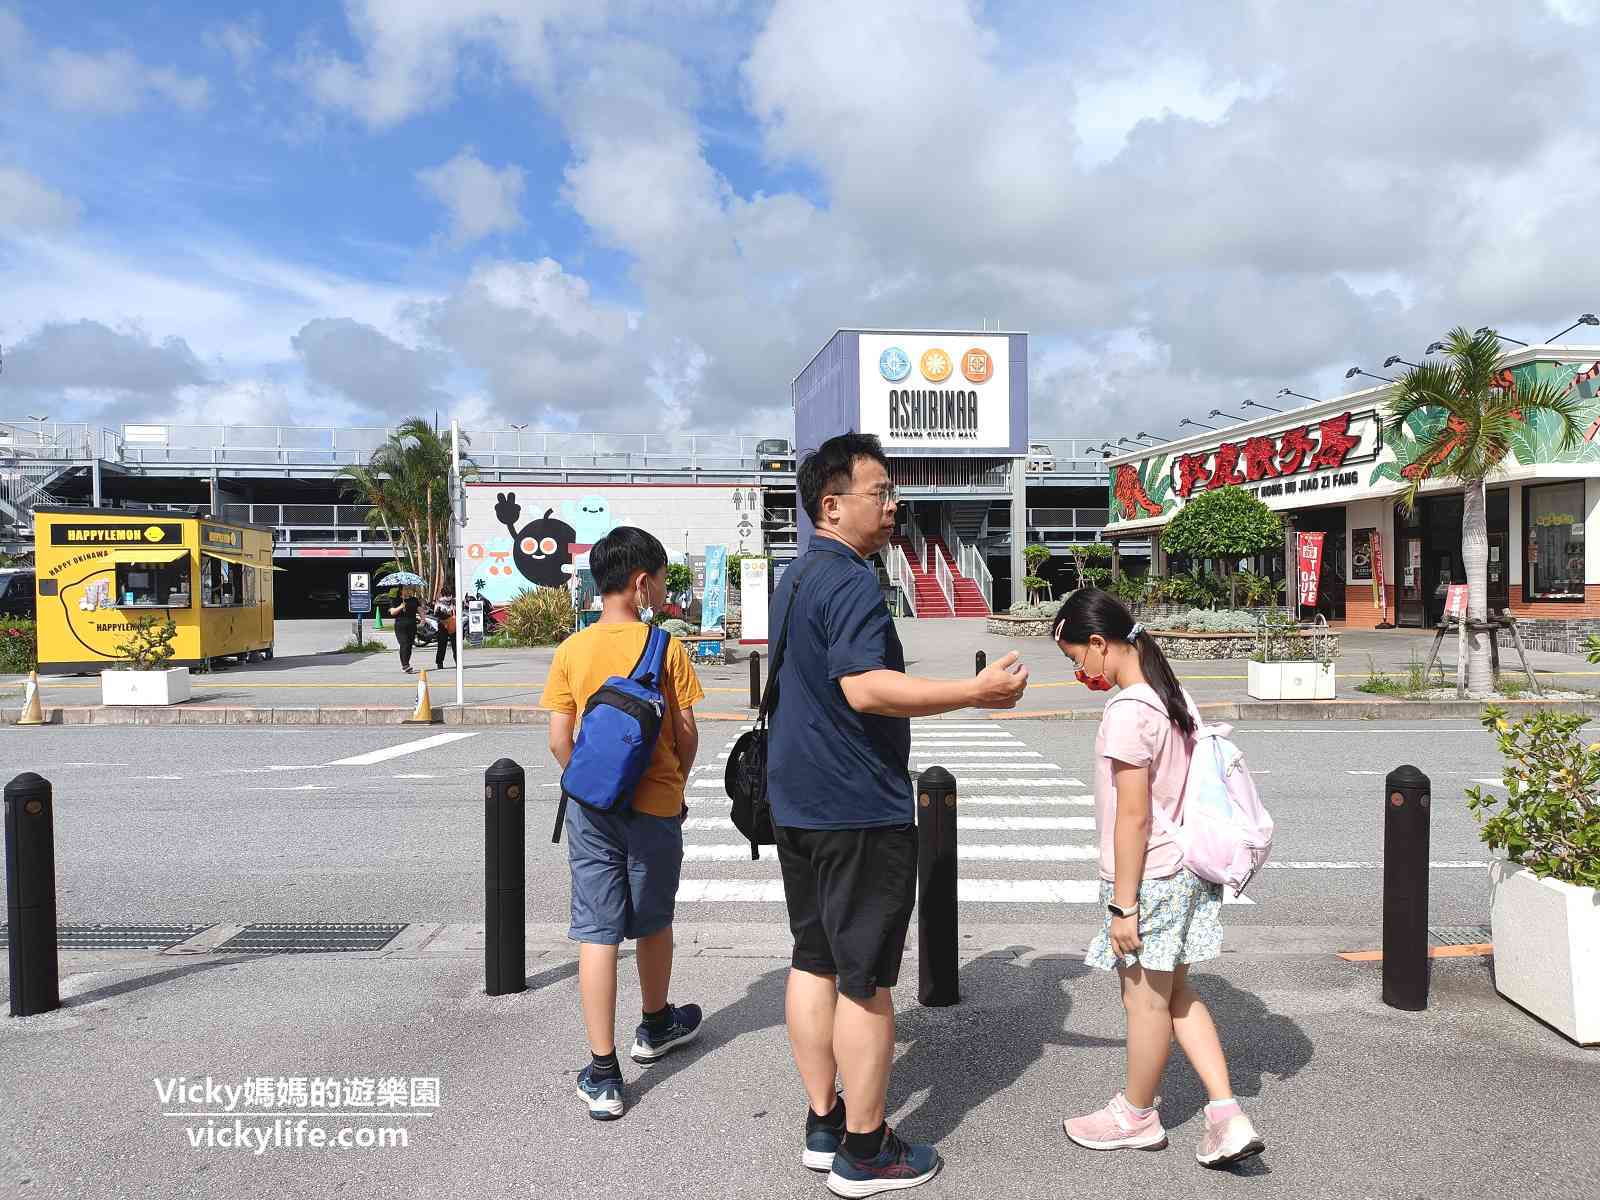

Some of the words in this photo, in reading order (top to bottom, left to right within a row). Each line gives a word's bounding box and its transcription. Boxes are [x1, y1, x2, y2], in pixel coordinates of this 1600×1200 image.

[889, 389, 978, 430] ASHIBINAA
[889, 431, 923, 439] OKINAWA
[927, 431, 956, 439] OUTLET
[958, 431, 977, 439] MALL
[1261, 483, 1283, 497] HONG
[1299, 477, 1319, 492] JIAO
[1321, 476, 1330, 488] ZI
[1333, 471, 1358, 487] FANG
[67, 529, 141, 541] HAPPYLEMON
[48, 560, 71, 576] HAPPY
[73, 550, 108, 564] OKINAWA
[470, 545, 480, 557] 2
[1300, 571, 1309, 605] OUT
[1308, 559, 1318, 603] TAKE
